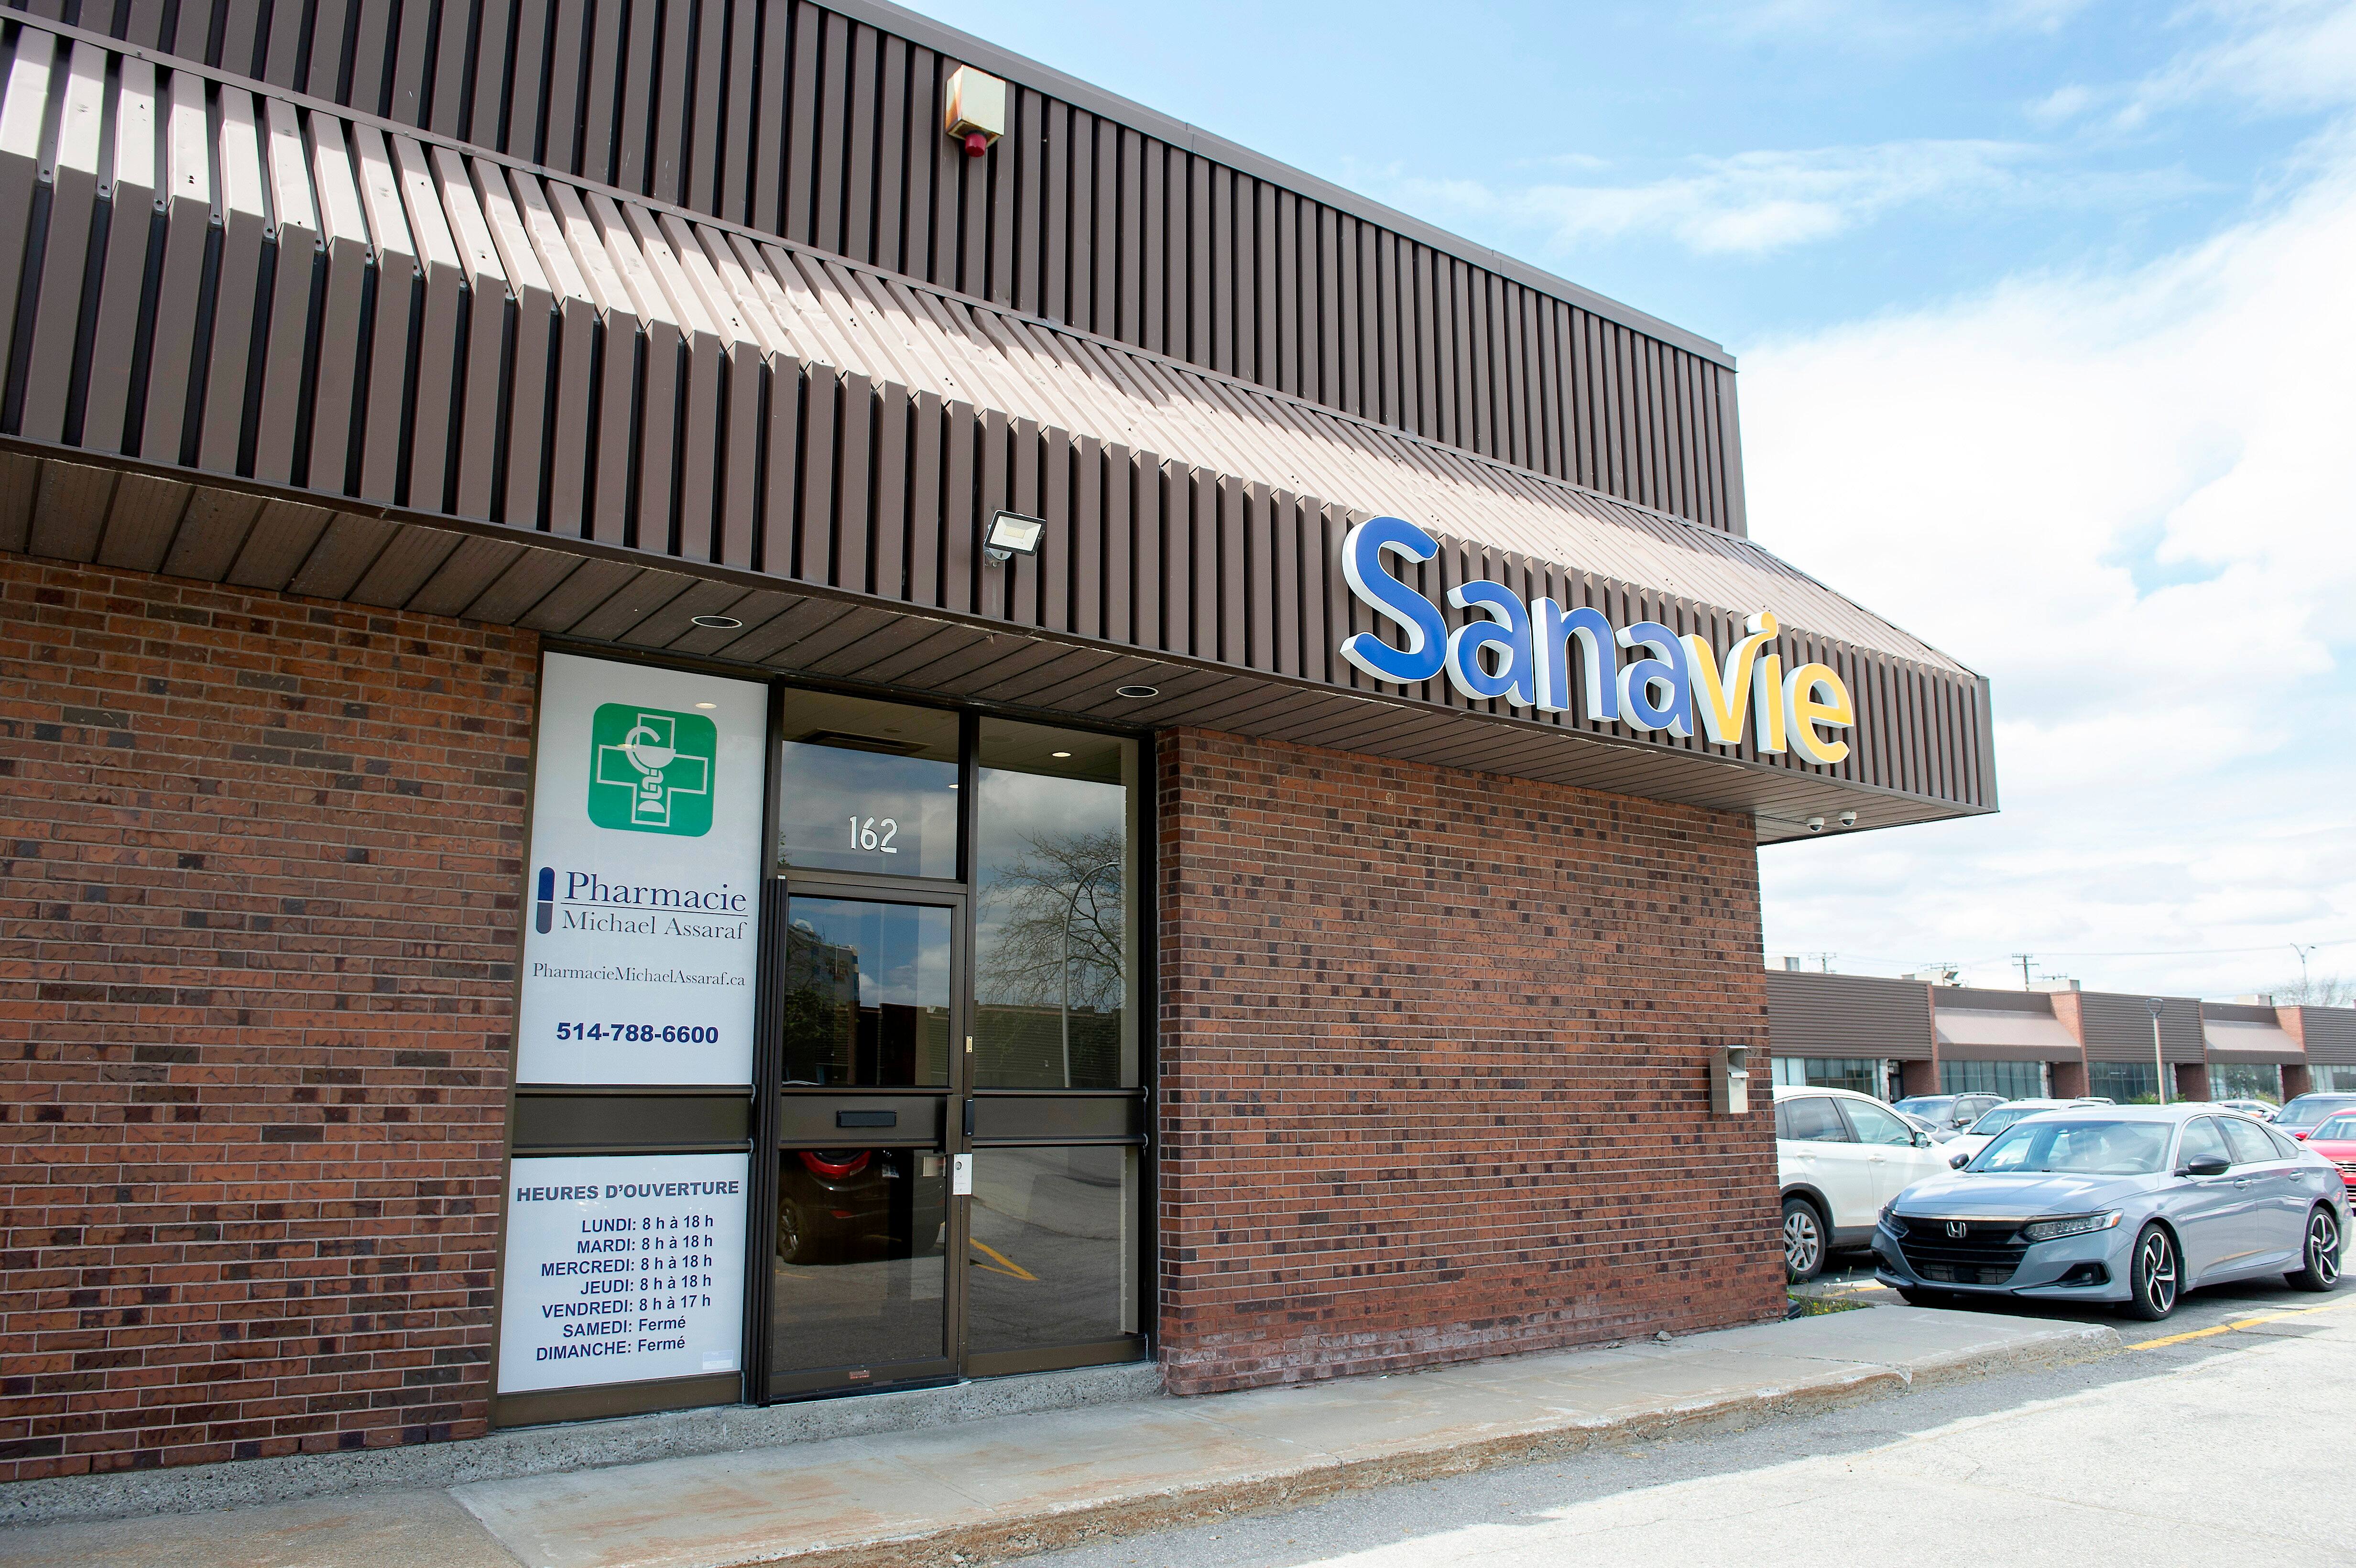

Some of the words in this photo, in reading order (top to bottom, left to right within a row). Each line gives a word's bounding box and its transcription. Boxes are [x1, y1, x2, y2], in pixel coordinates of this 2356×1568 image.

[850, 816, 897, 853] 162
[566, 872, 746, 912] Pharmacie
[562, 910, 655, 934] Michael
[665, 917, 747, 939] Assaraf
[534, 963, 744, 985] PharmacieMichaelAssaraf.ca
[556, 1023, 718, 1043] 514-788-6600
[517, 1186, 598, 1201] HEURES
[606, 1181, 739, 1198] D’OUVERTURE
[582, 1219, 636, 1232] LUNDI:
[643, 1218, 650, 1230] 8
[656, 1217, 664, 1229] h
[670, 1216, 677, 1228] à
[684, 1215, 699, 1228] 18
[706, 1215, 713, 1227] h
[578, 1239, 635, 1253] MARDI:
[642, 1238, 649, 1250] 8
[656, 1237, 663, 1249] h
[669, 1236, 677, 1248] à
[684, 1235, 698, 1247] 18
[705, 1235, 712, 1246] h
[542, 1259, 634, 1276] MERCREDI:
[641, 1258, 649, 1270] 8
[655, 1257, 663, 1269] h
[669, 1256, 676, 1268] à
[683, 1255, 698, 1267] 18
[704, 1254, 711, 1266] h
[581, 1279, 633, 1294] JEUDI:
[641, 1278, 648, 1290] 8
[654, 1277, 662, 1289] h
[668, 1276, 675, 1288] à
[682, 1275, 697, 1287] 18
[703, 1274, 710, 1286] h
[542, 1300, 632, 1318] VENDREDI:
[640, 1298, 647, 1311] 8
[654, 1298, 661, 1310] h
[667, 1296, 674, 1309] à
[681, 1295, 697, 1307] 17
[703, 1294, 710, 1306] h
[563, 1320, 632, 1337] SAMEDI:
[639, 1316, 686, 1331] Fermé
[537, 1341, 631, 1361] DIMANCHE:
[638, 1336, 685, 1351] Fermé
